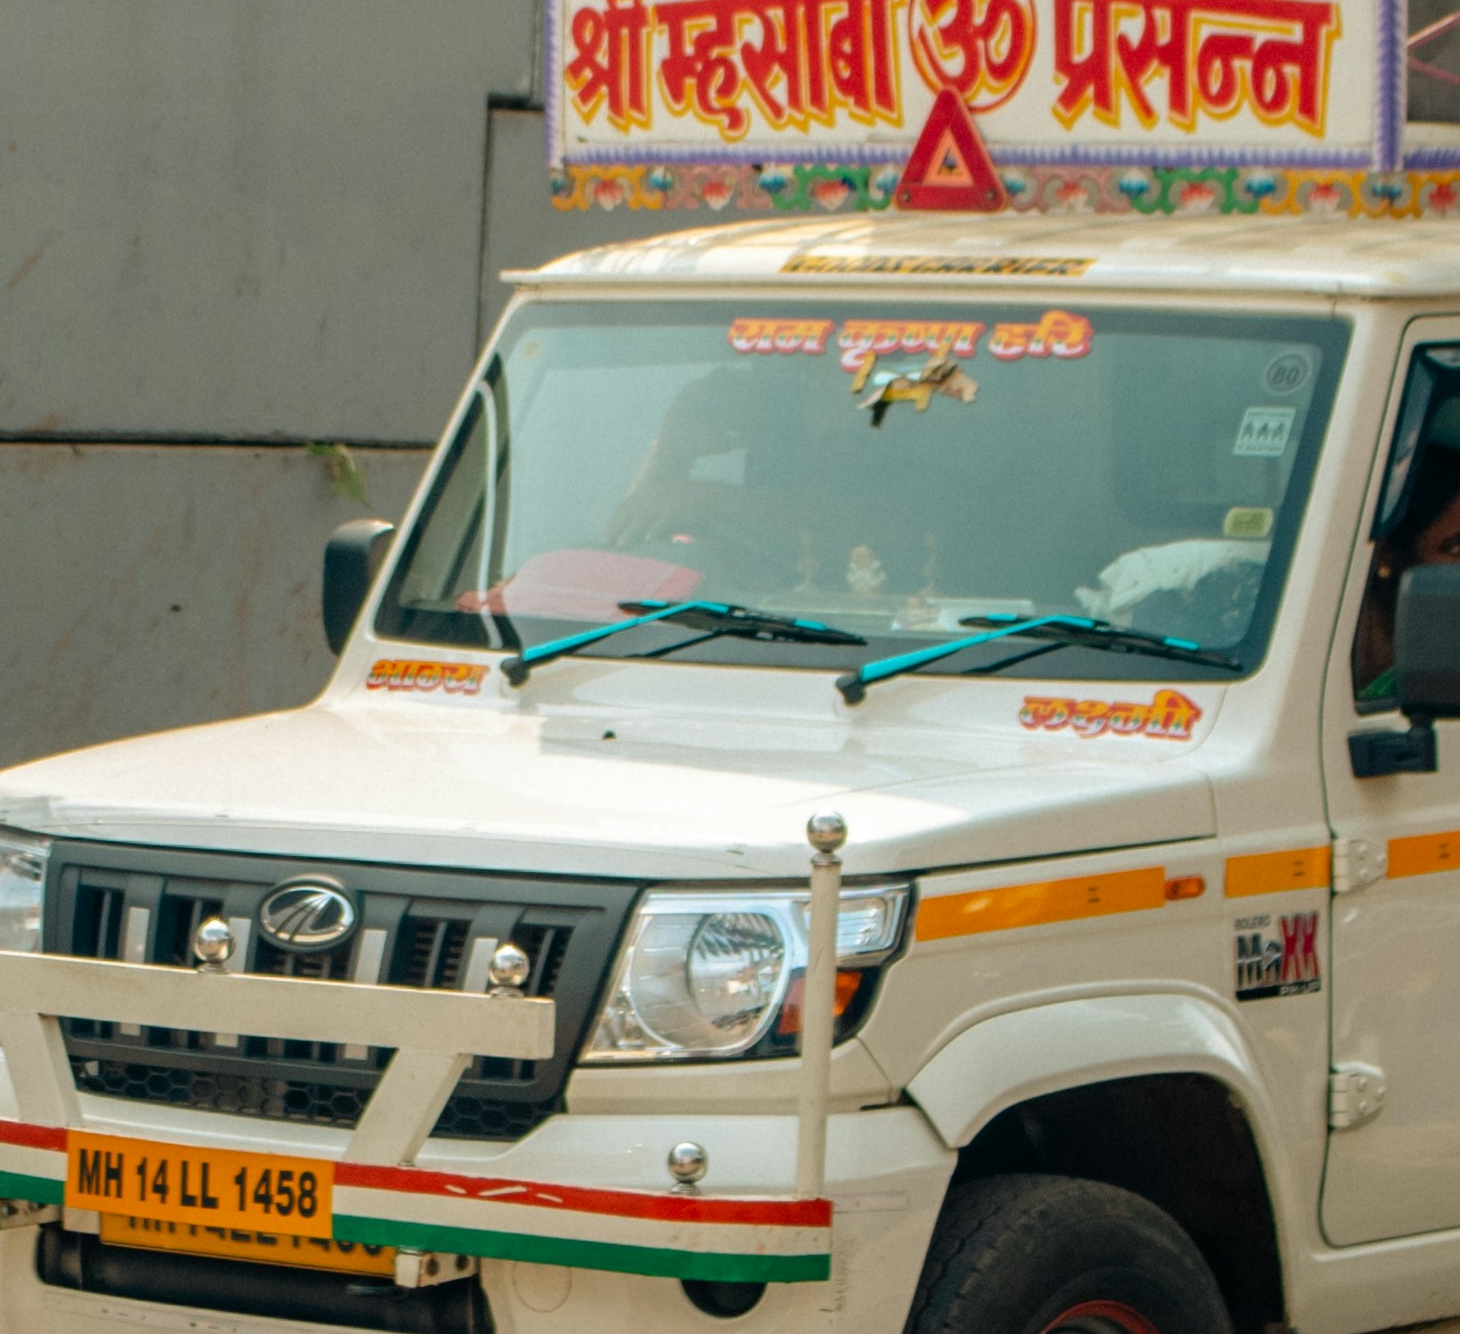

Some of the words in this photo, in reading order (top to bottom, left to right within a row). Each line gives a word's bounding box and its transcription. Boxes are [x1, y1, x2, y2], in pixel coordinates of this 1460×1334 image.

[728, 318, 834, 354] राम
[837, 319, 986, 374] कृष्ण
[988, 309, 1094, 361] हरि
[1018, 688, 1203, 742] लक्ष्मी
[78, 1147, 124, 1199] MH
[136, 1156, 169, 1204] 14
[180, 1160, 219, 1209] LL
[234, 1166, 318, 1218] 1458
